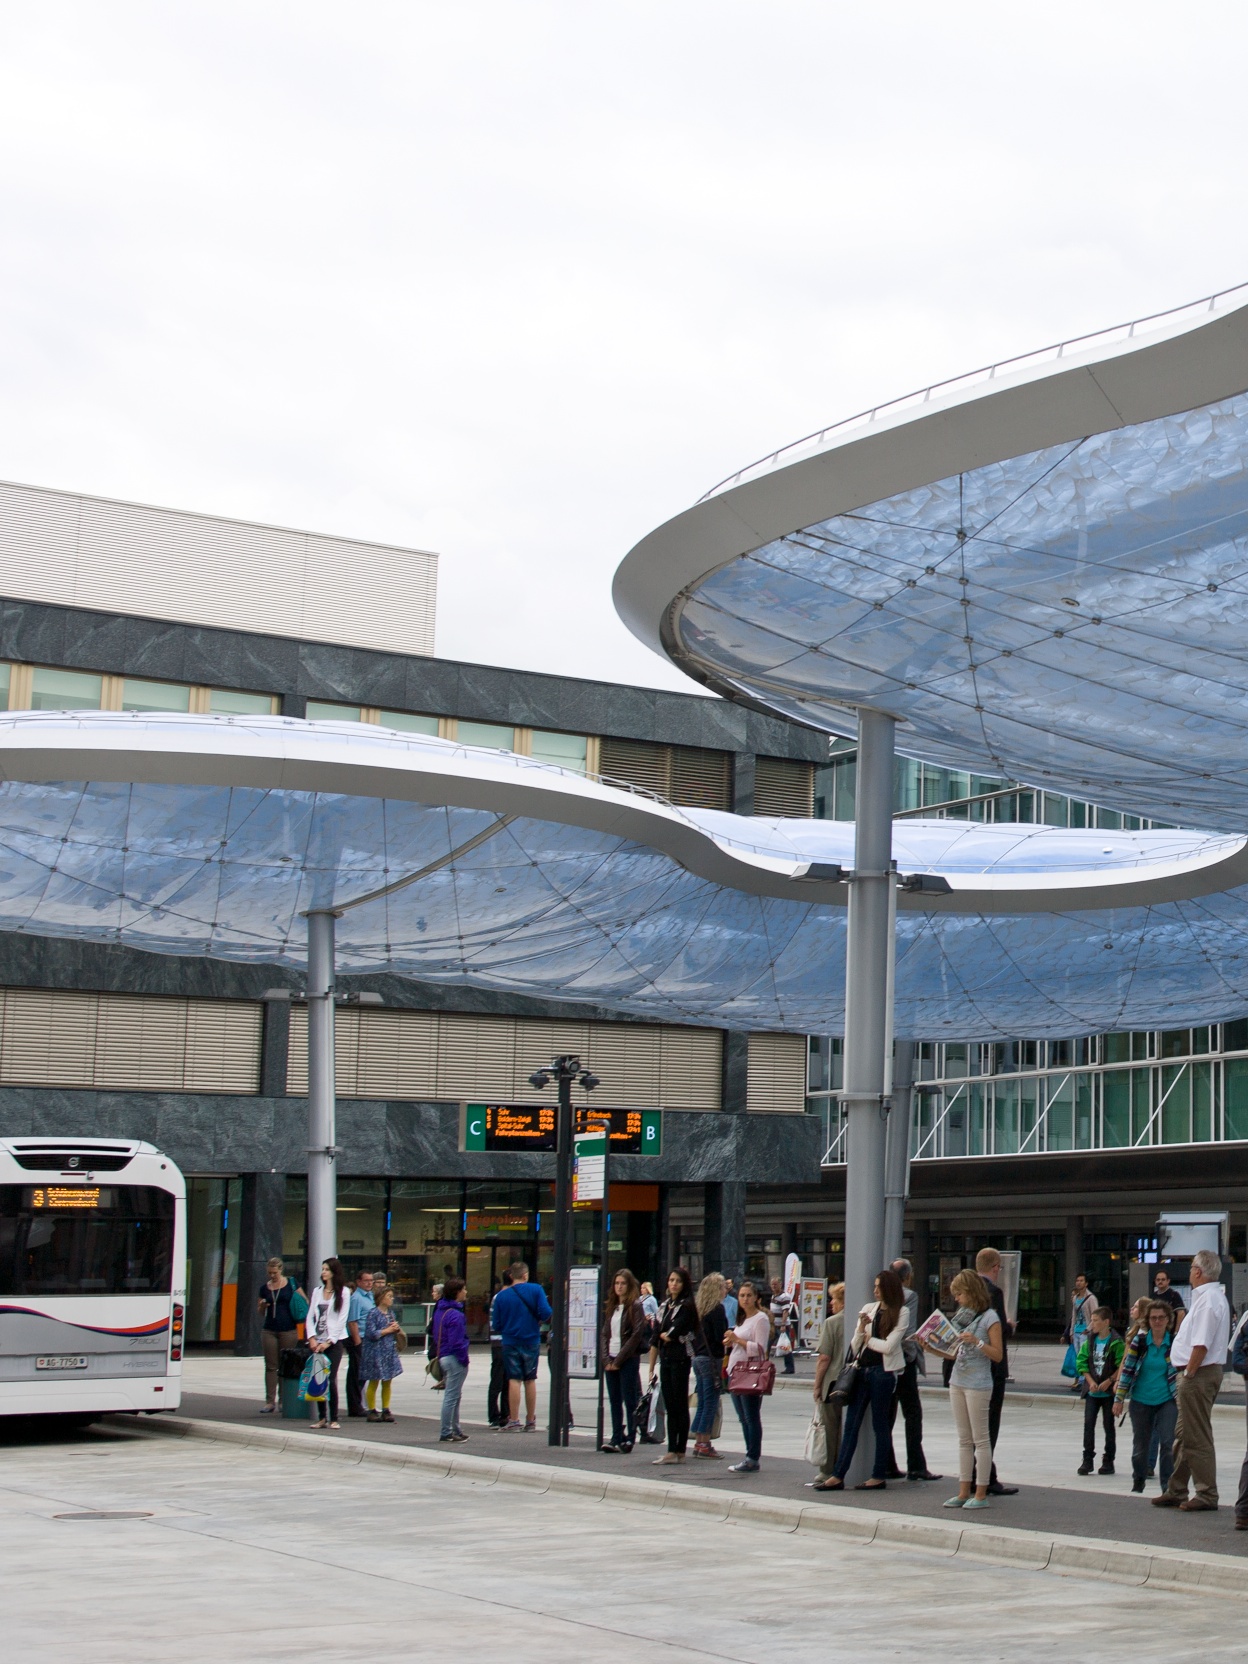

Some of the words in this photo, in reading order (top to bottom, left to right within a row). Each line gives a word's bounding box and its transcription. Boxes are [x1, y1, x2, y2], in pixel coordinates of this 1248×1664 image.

[470, 1120, 481, 1136] C
[646, 1126, 656, 1140] B
[575, 1142, 580, 1156] C
[34, 1190, 44, 1206] 3
